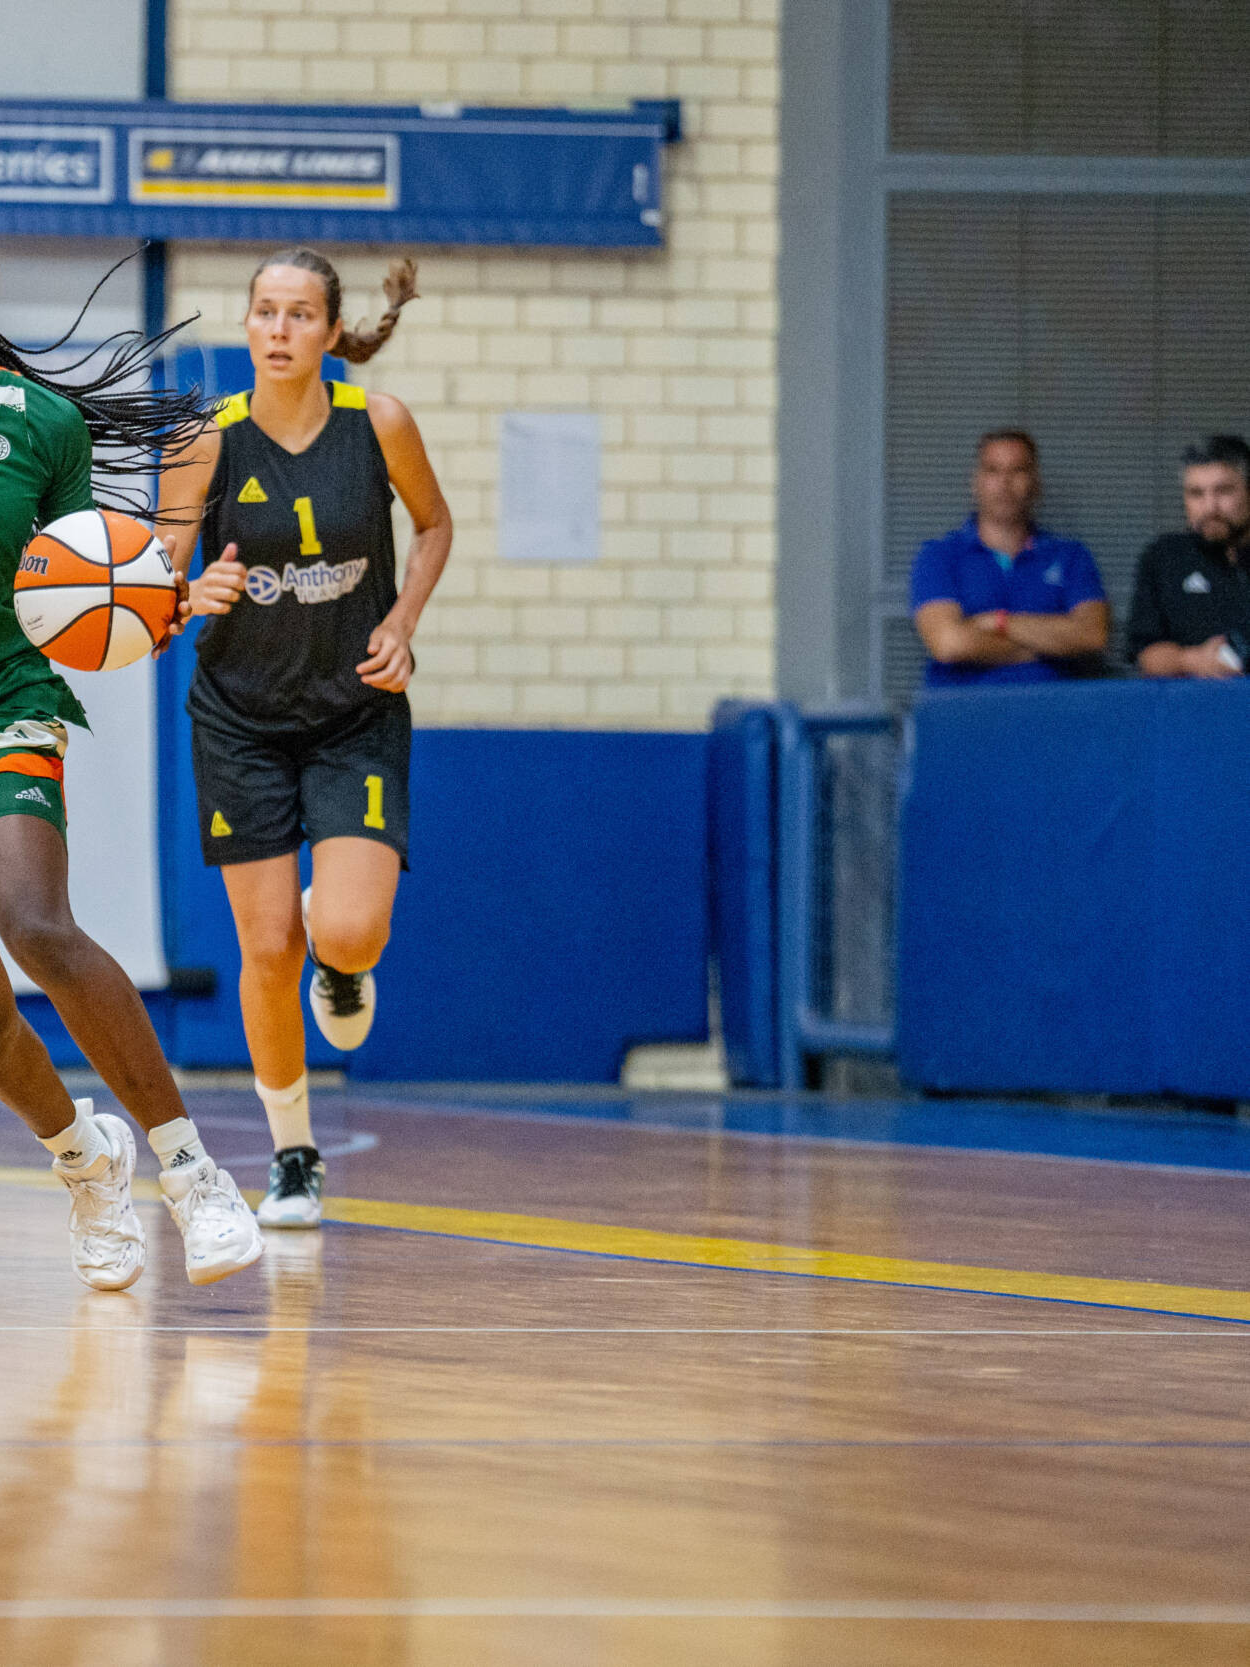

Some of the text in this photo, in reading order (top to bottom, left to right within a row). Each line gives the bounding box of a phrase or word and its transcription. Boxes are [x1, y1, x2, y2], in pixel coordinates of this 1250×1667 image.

[293, 496, 323, 556] 1
[284, 562, 364, 587] Anthony
[364, 774, 386, 830] 1
